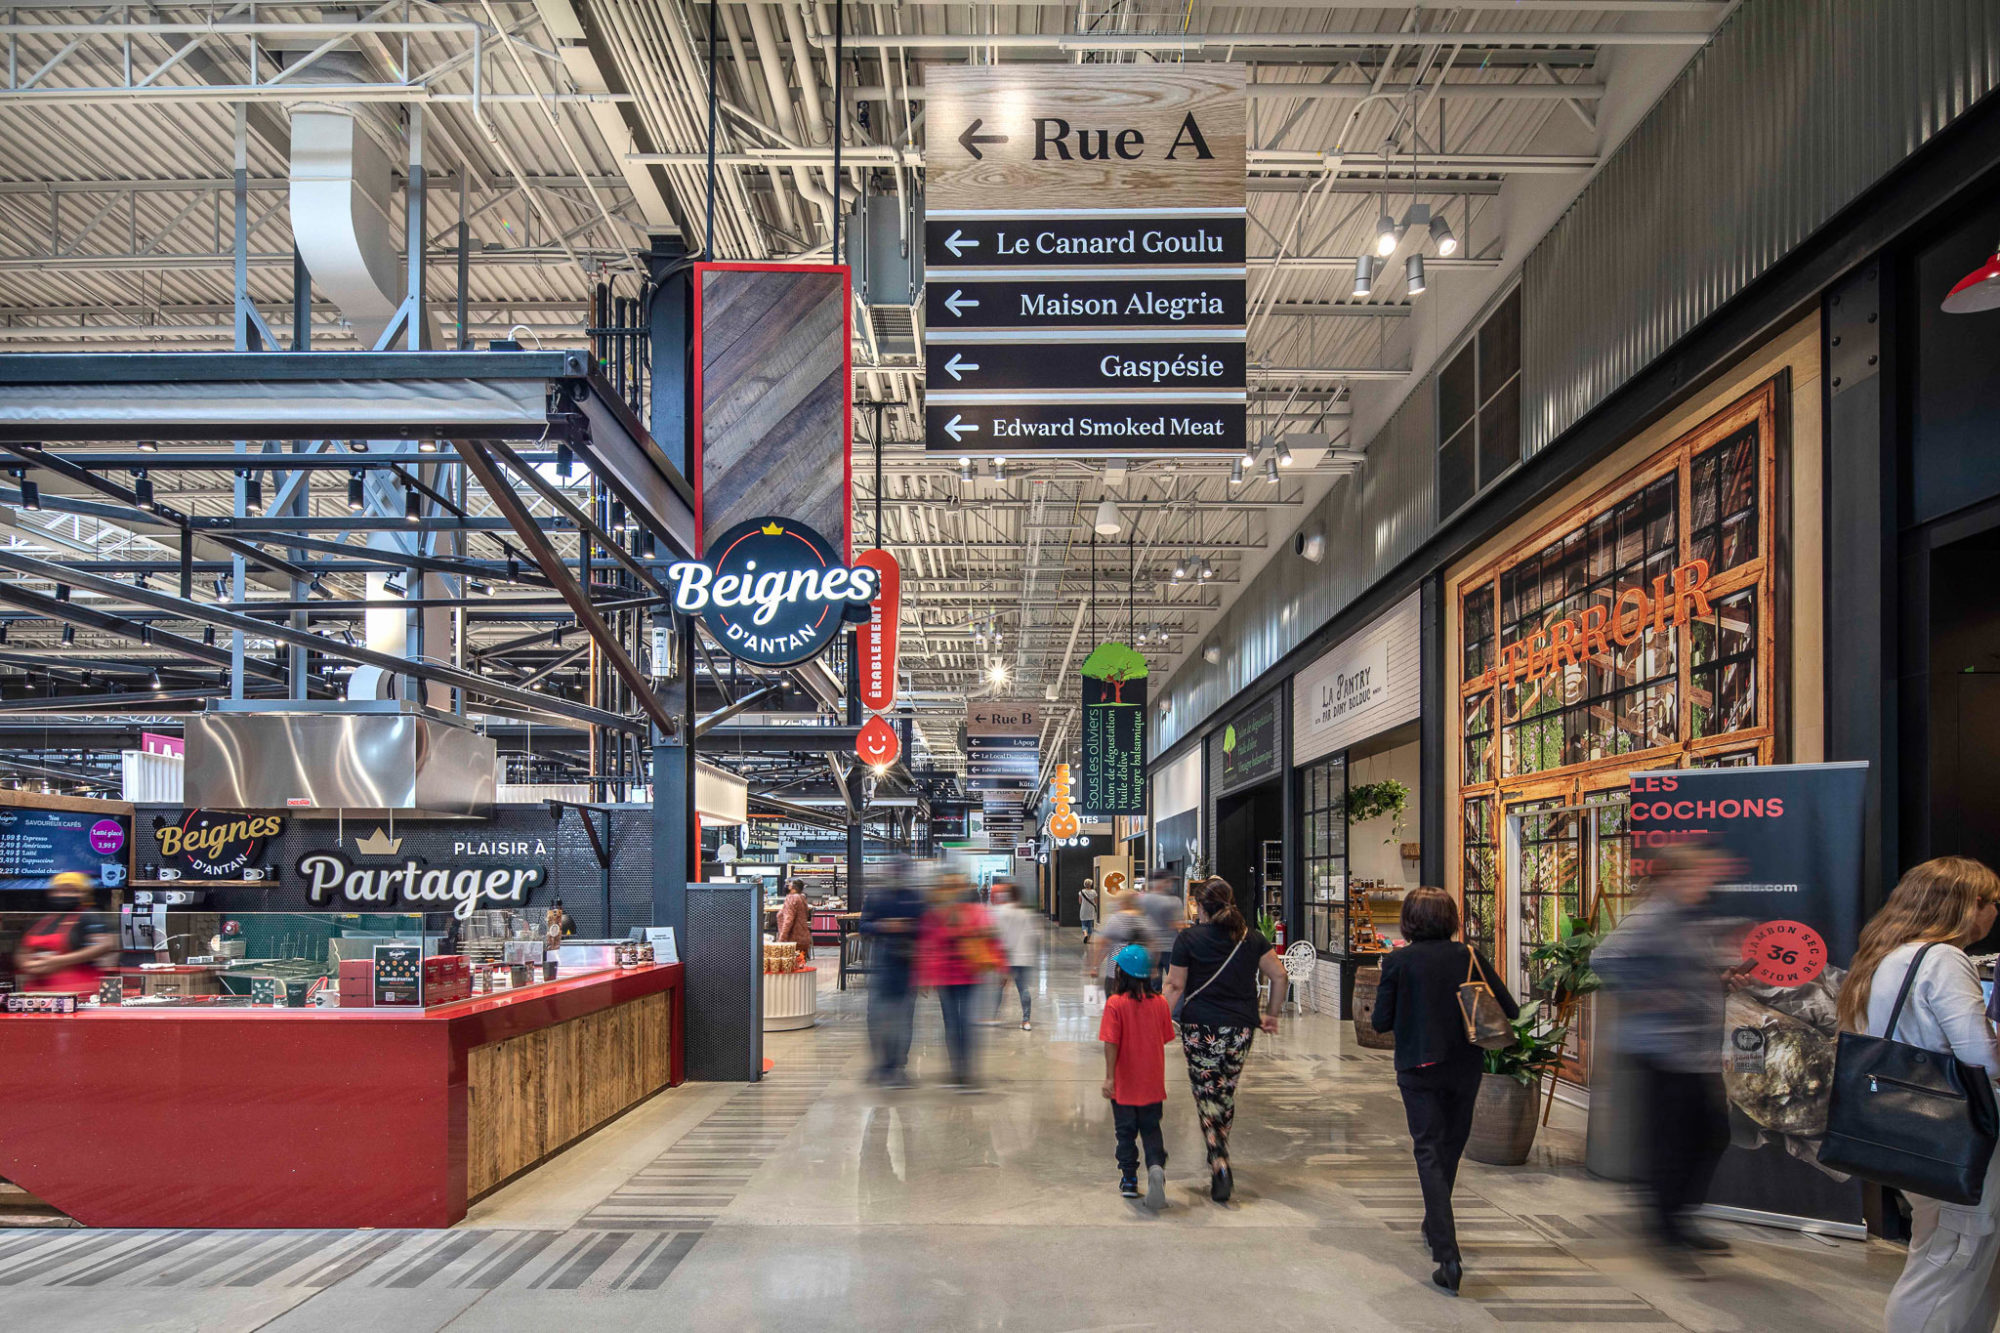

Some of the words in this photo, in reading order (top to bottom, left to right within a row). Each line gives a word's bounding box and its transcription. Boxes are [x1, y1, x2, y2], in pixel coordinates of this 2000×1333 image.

[1032, 117, 1145, 160] Rue
[1164, 110, 1215, 160] A
[996, 232, 1030, 254] Le
[1036, 230, 1135, 254] Canard
[1142, 229, 1223, 252] Goulu
[1020, 293, 1117, 316] Maison
[1124, 292, 1223, 320] Alegria
[1100, 354, 1224, 382] Gaspésie
[992, 418, 1075, 437] Edward
[1079, 417, 1165, 436] Smoked
[1170, 417, 1224, 436] Meat
[668, 560, 875, 625] Beignes
[1501, 558, 1712, 690] TERROIR
[726, 623, 817, 654] D'ANTAN
[868, 606, 882, 698] ÉRABLEMENT
[1322, 685, 1334, 708] LA
[1336, 665, 1371, 701] PANTRY
[992, 713, 1018, 725] Rue
[1022, 712, 1032, 725] B
[1322, 709, 1331, 723] PAR
[1086, 709, 1099, 755] oliviers
[1104, 709, 1119, 767] dégustation
[1130, 710, 1145, 766] balsamique
[1086, 757, 1099, 776] les
[1104, 768, 1115, 781] de
[1116, 751, 1128, 781] d'olive
[1086, 777, 1099, 810] Sous
[1104, 783, 1115, 810] Salon
[1117, 782, 1128, 809] Huile
[1130, 768, 1145, 810] Vinaigre
[1630, 776, 1679, 793] LES
[1630, 797, 1784, 821] COCHONS
[156, 815, 281, 859] Beignes
[455, 842, 528, 855] PLAISIR
[535, 839, 547, 855] À
[192, 853, 248, 875] D'ANTAN
[300, 855, 538, 921] Partager
[1748, 925, 1798, 955] JAMBON
[1801, 933, 1820, 955] SEC
[1767, 944, 1799, 965] 36
[1803, 959, 1817, 974] 36
[1760, 968, 1799, 982] MOIS
